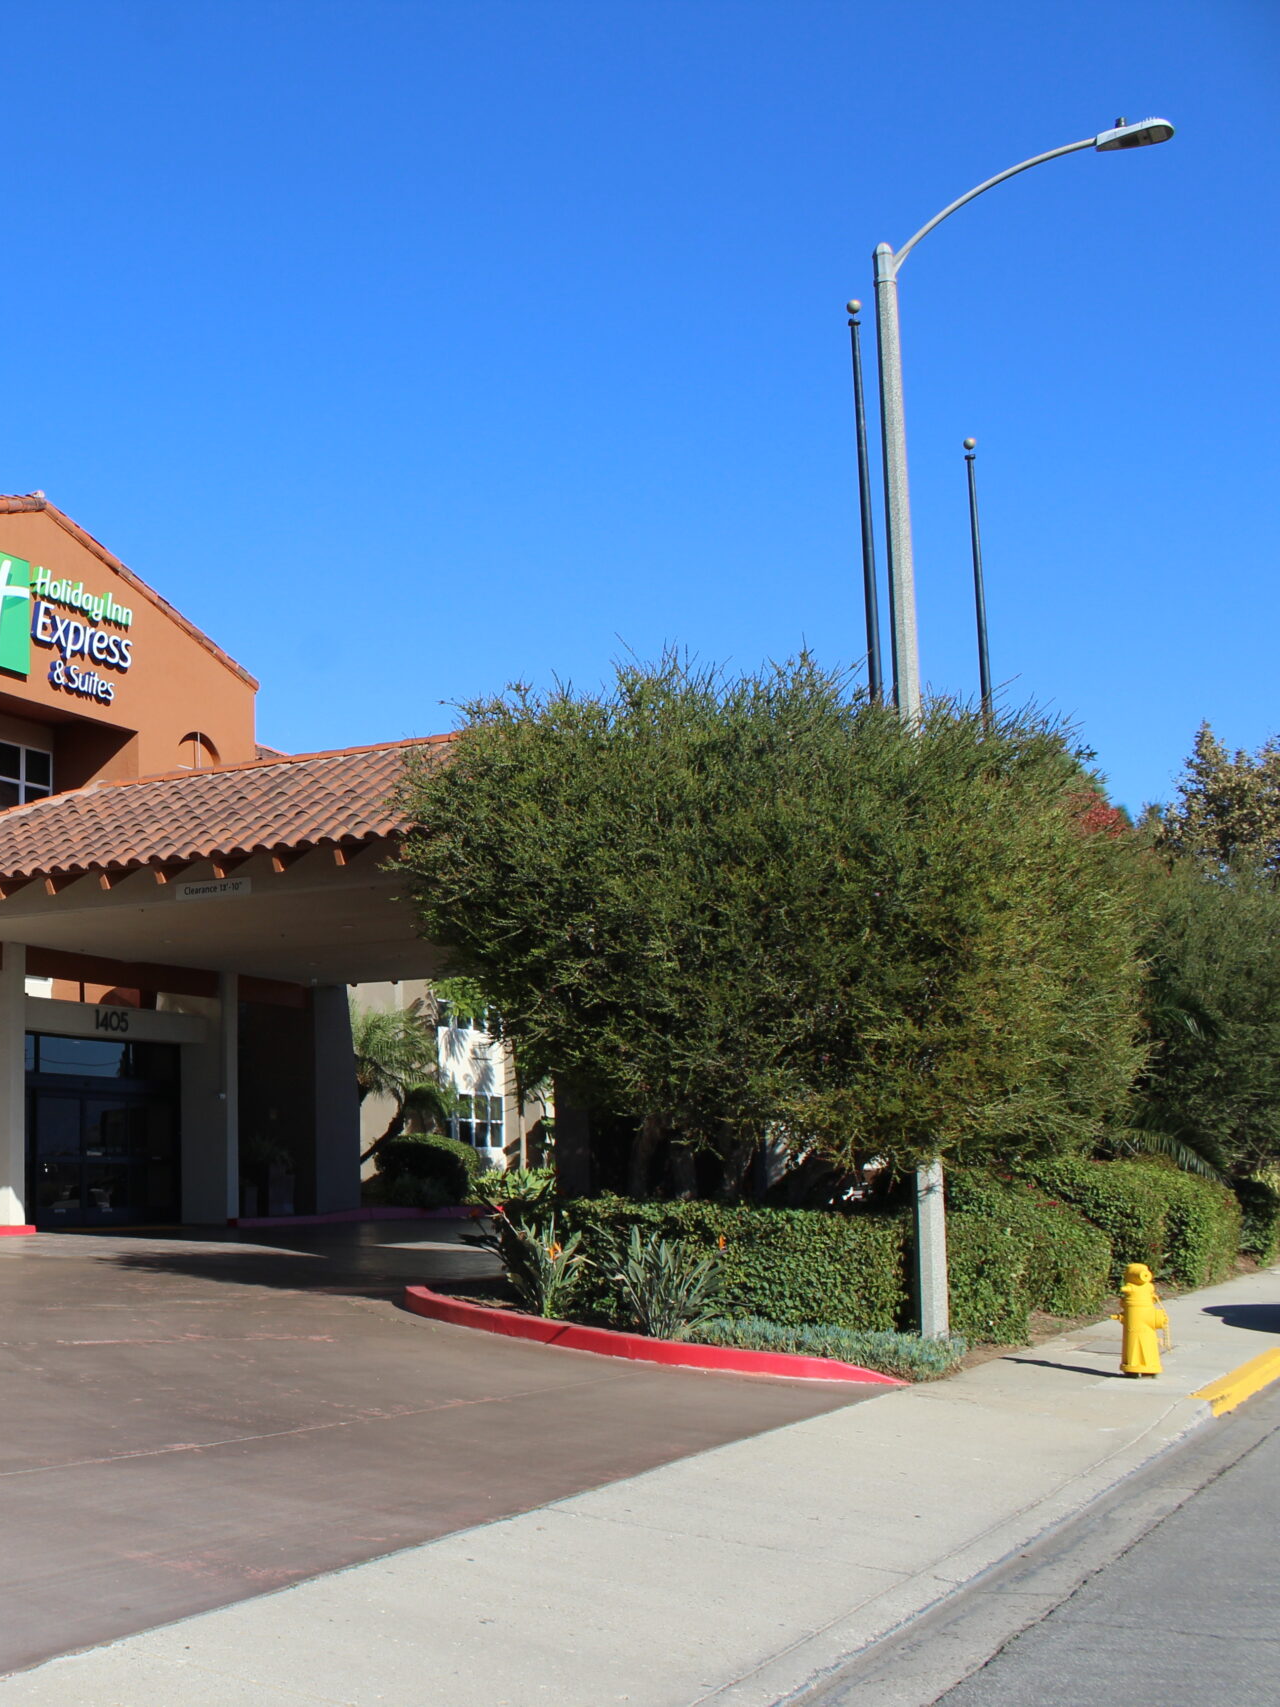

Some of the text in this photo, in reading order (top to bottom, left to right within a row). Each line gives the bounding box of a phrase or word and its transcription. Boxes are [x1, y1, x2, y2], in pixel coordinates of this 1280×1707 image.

[33, 566, 133, 626] Holiday Inn
[34, 601, 133, 669] Express
[50, 660, 116, 701] & Suites
[184, 885, 218, 896] Clearance
[95, 1008, 129, 1033] 1405
